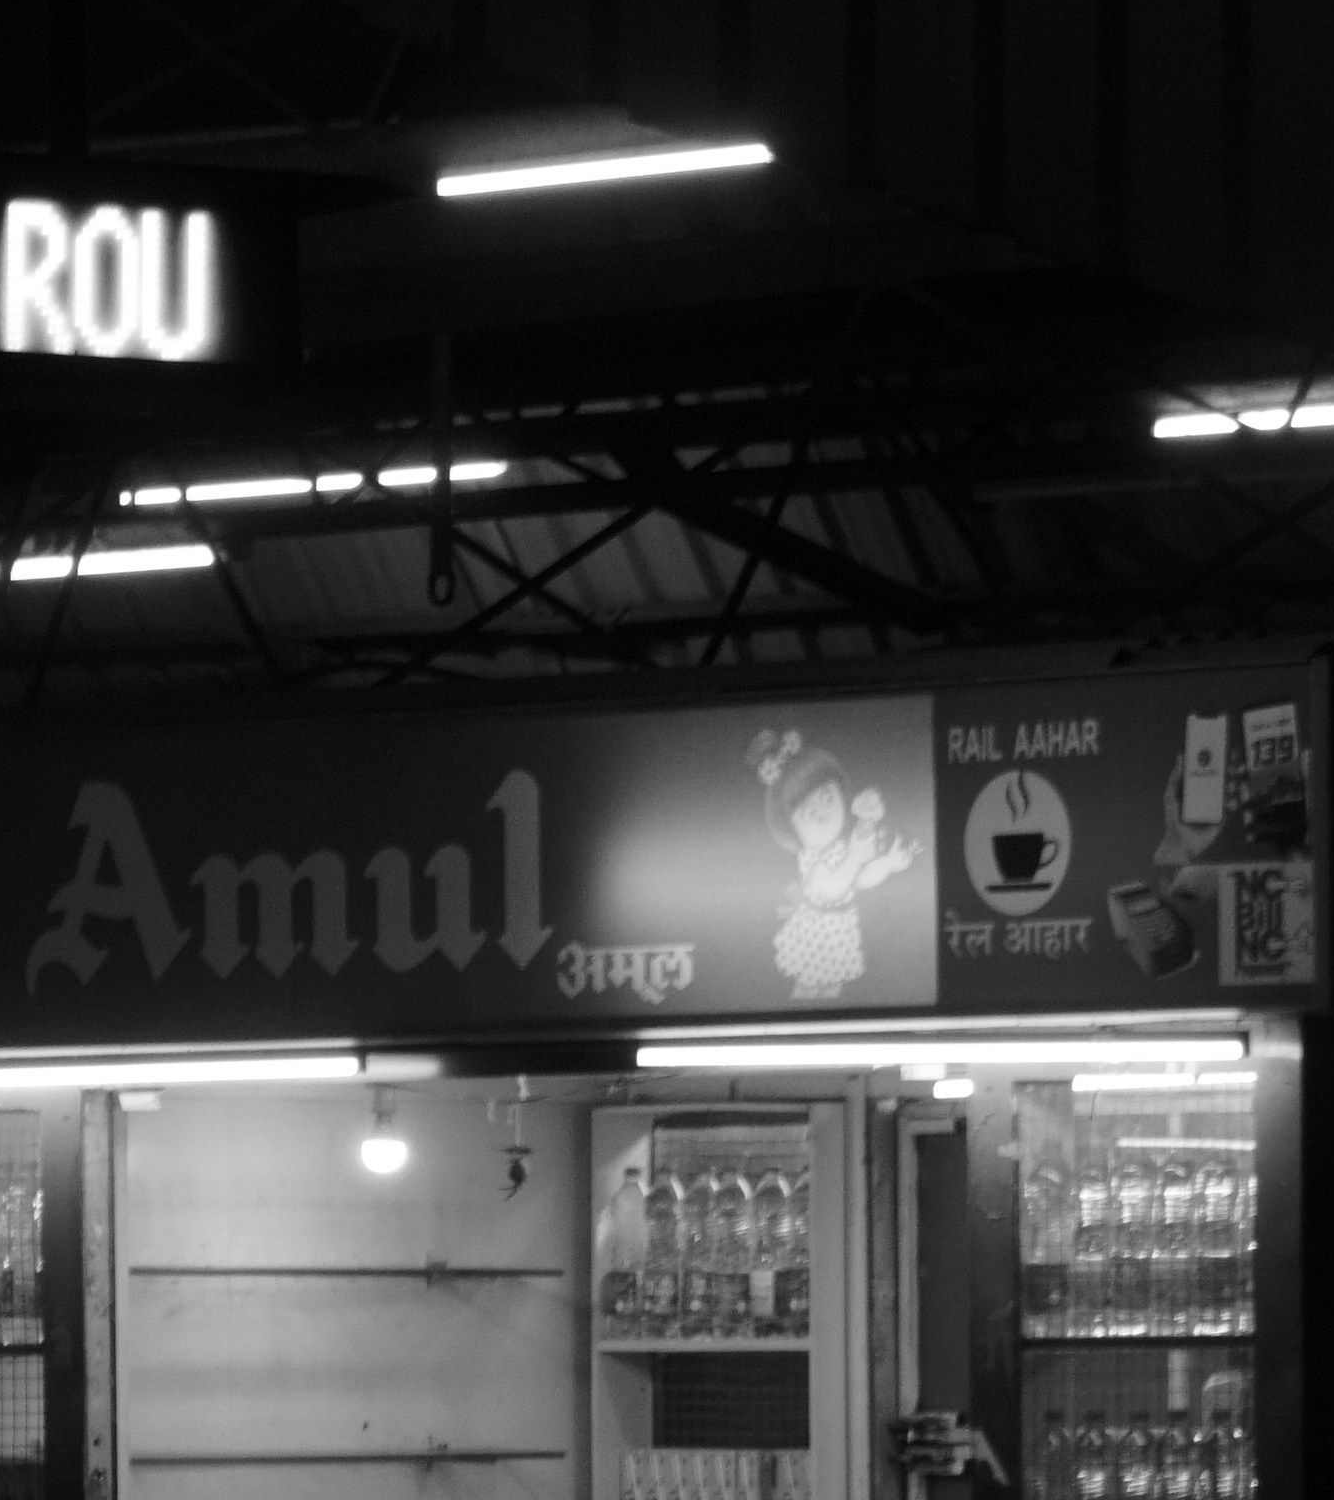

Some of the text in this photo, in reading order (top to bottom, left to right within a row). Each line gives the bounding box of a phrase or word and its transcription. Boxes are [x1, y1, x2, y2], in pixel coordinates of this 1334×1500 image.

[948, 719, 1100, 764] RAIL AAHAR
[25, 768, 553, 998] Amul
[944, 909, 1093, 960] रेल आहार
[557, 941, 695, 1005] अमूल
